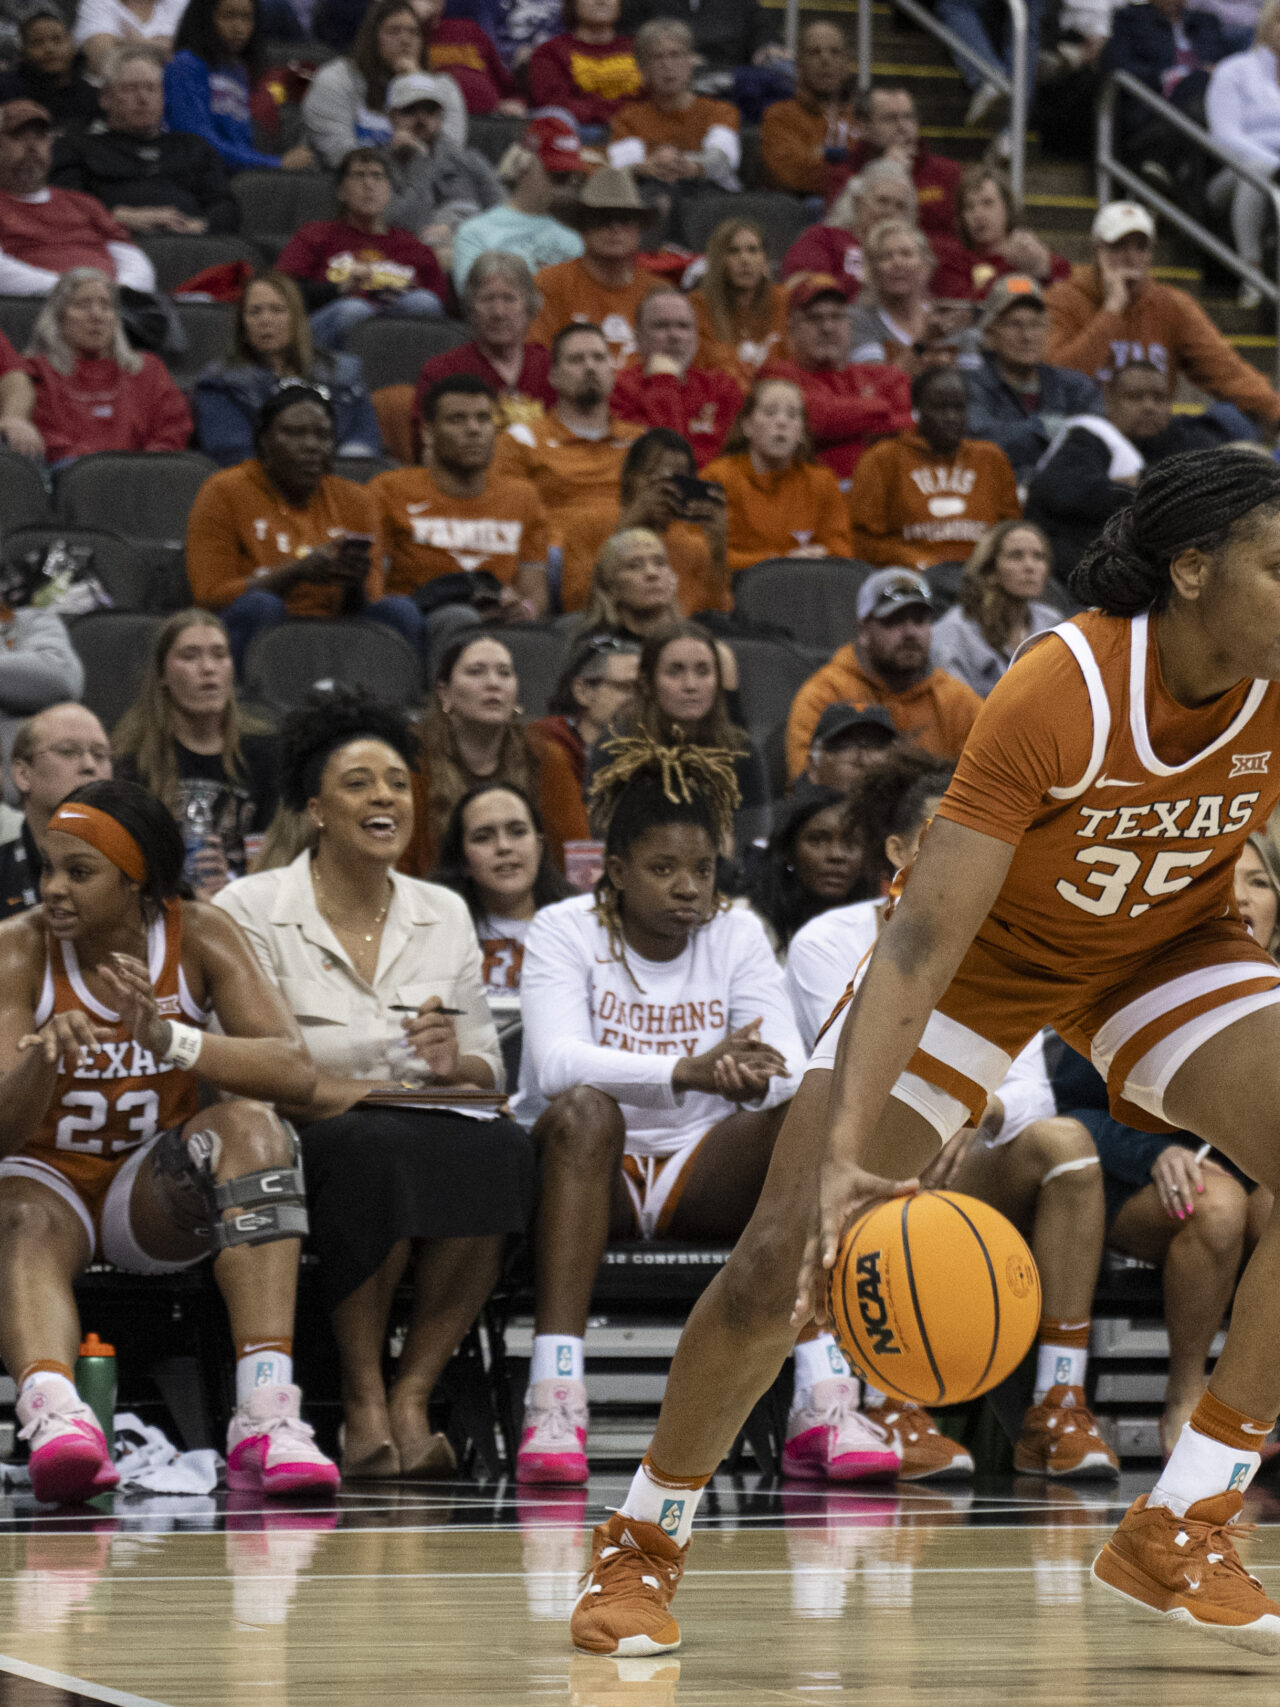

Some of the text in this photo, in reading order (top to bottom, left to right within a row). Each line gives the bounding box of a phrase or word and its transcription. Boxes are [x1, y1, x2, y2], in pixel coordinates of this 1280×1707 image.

[1229, 752, 1271, 778] XII
[1075, 791, 1261, 840] TEXAS
[1055, 845, 1214, 918] 35
[57, 1040, 174, 1079] EXA
[56, 1089, 159, 1154] 23
[632, 1252, 732, 1264] CONFERENC
[856, 1250, 902, 1355] NCAA
